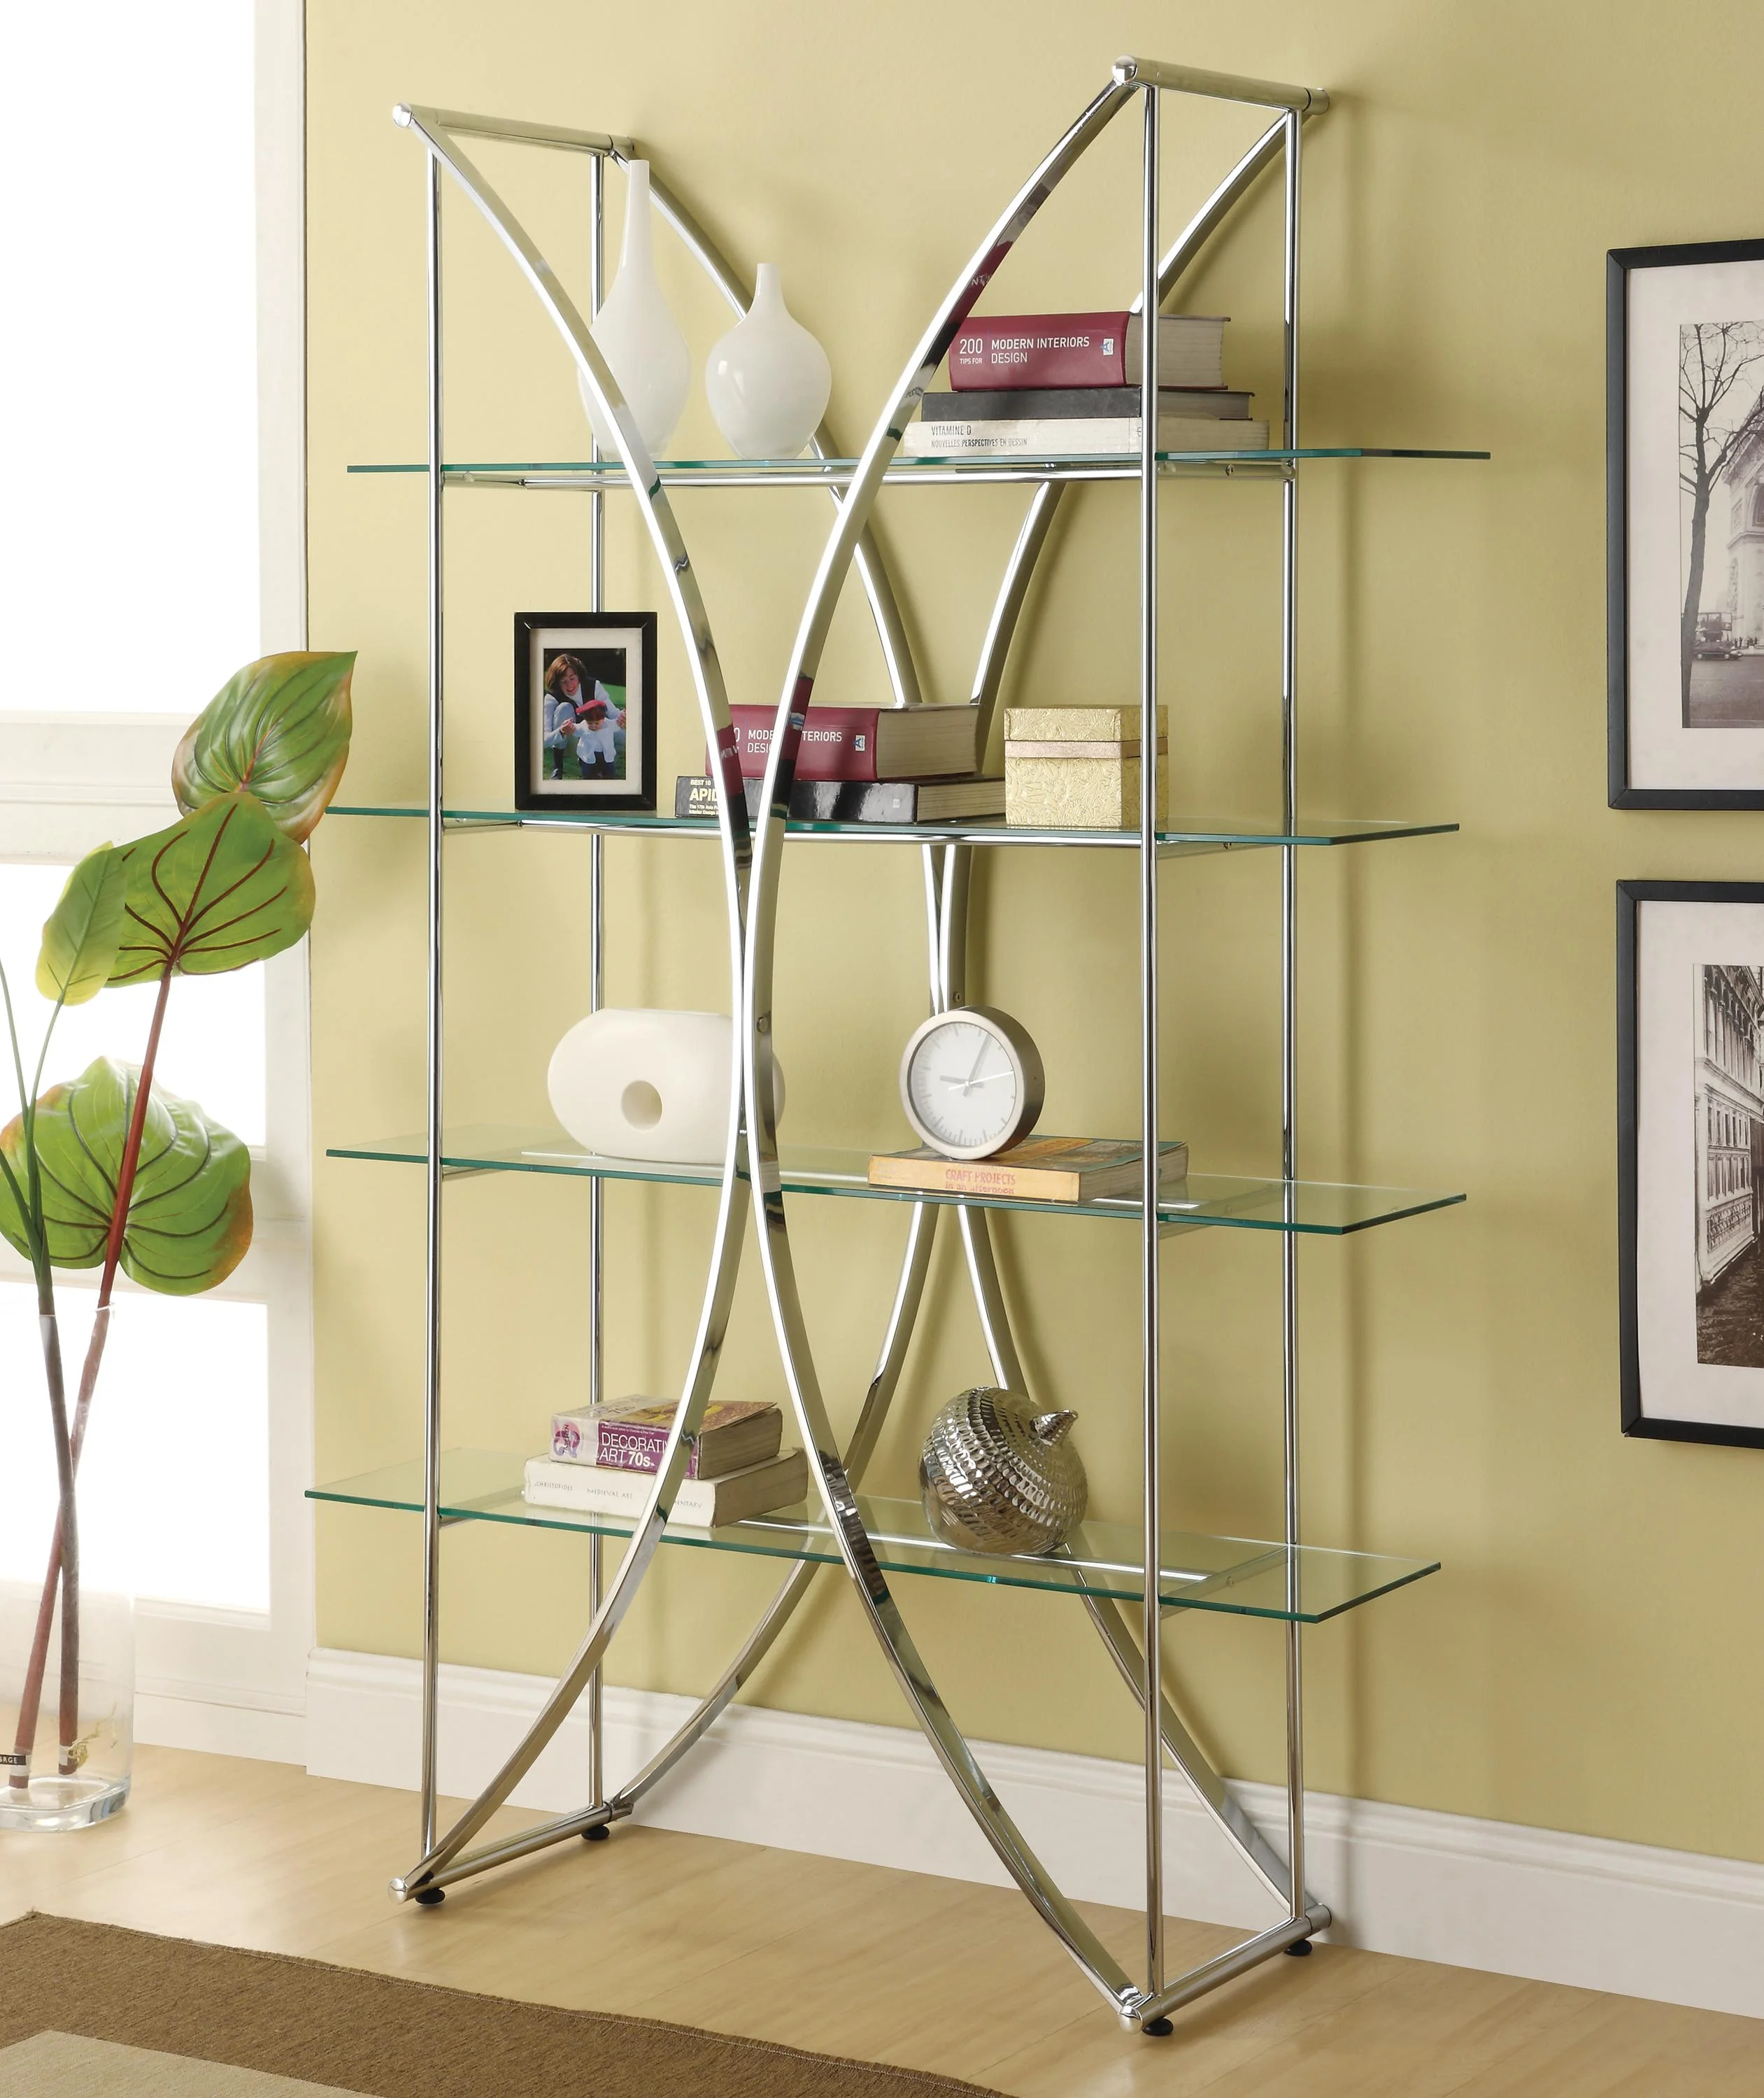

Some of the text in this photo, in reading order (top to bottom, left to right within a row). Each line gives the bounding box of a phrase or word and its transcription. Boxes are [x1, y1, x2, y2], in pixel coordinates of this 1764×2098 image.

[960, 338, 983, 355] 200
[991, 336, 1090, 350] MODERN INTERIORS
[991, 352, 1027, 364] DESIGN
[931, 425, 972, 436] VITAMINE D
[931, 439, 960, 448] NOUVELLES
[962, 438, 998, 448] PERSPECTIVES
[802, 731, 842, 742] TERIORS
[747, 743, 771, 753] DESI
[946, 1169, 1016, 1185] CRAFT PROJECTS
[946, 1181, 953, 1190] in
[970, 1185, 1014, 1194] afternoon
[602, 1432, 667, 1453] DECORATI
[599, 1447, 650, 1467] ART 70s
[587, 1487, 619, 1497] MEDIEVAL
